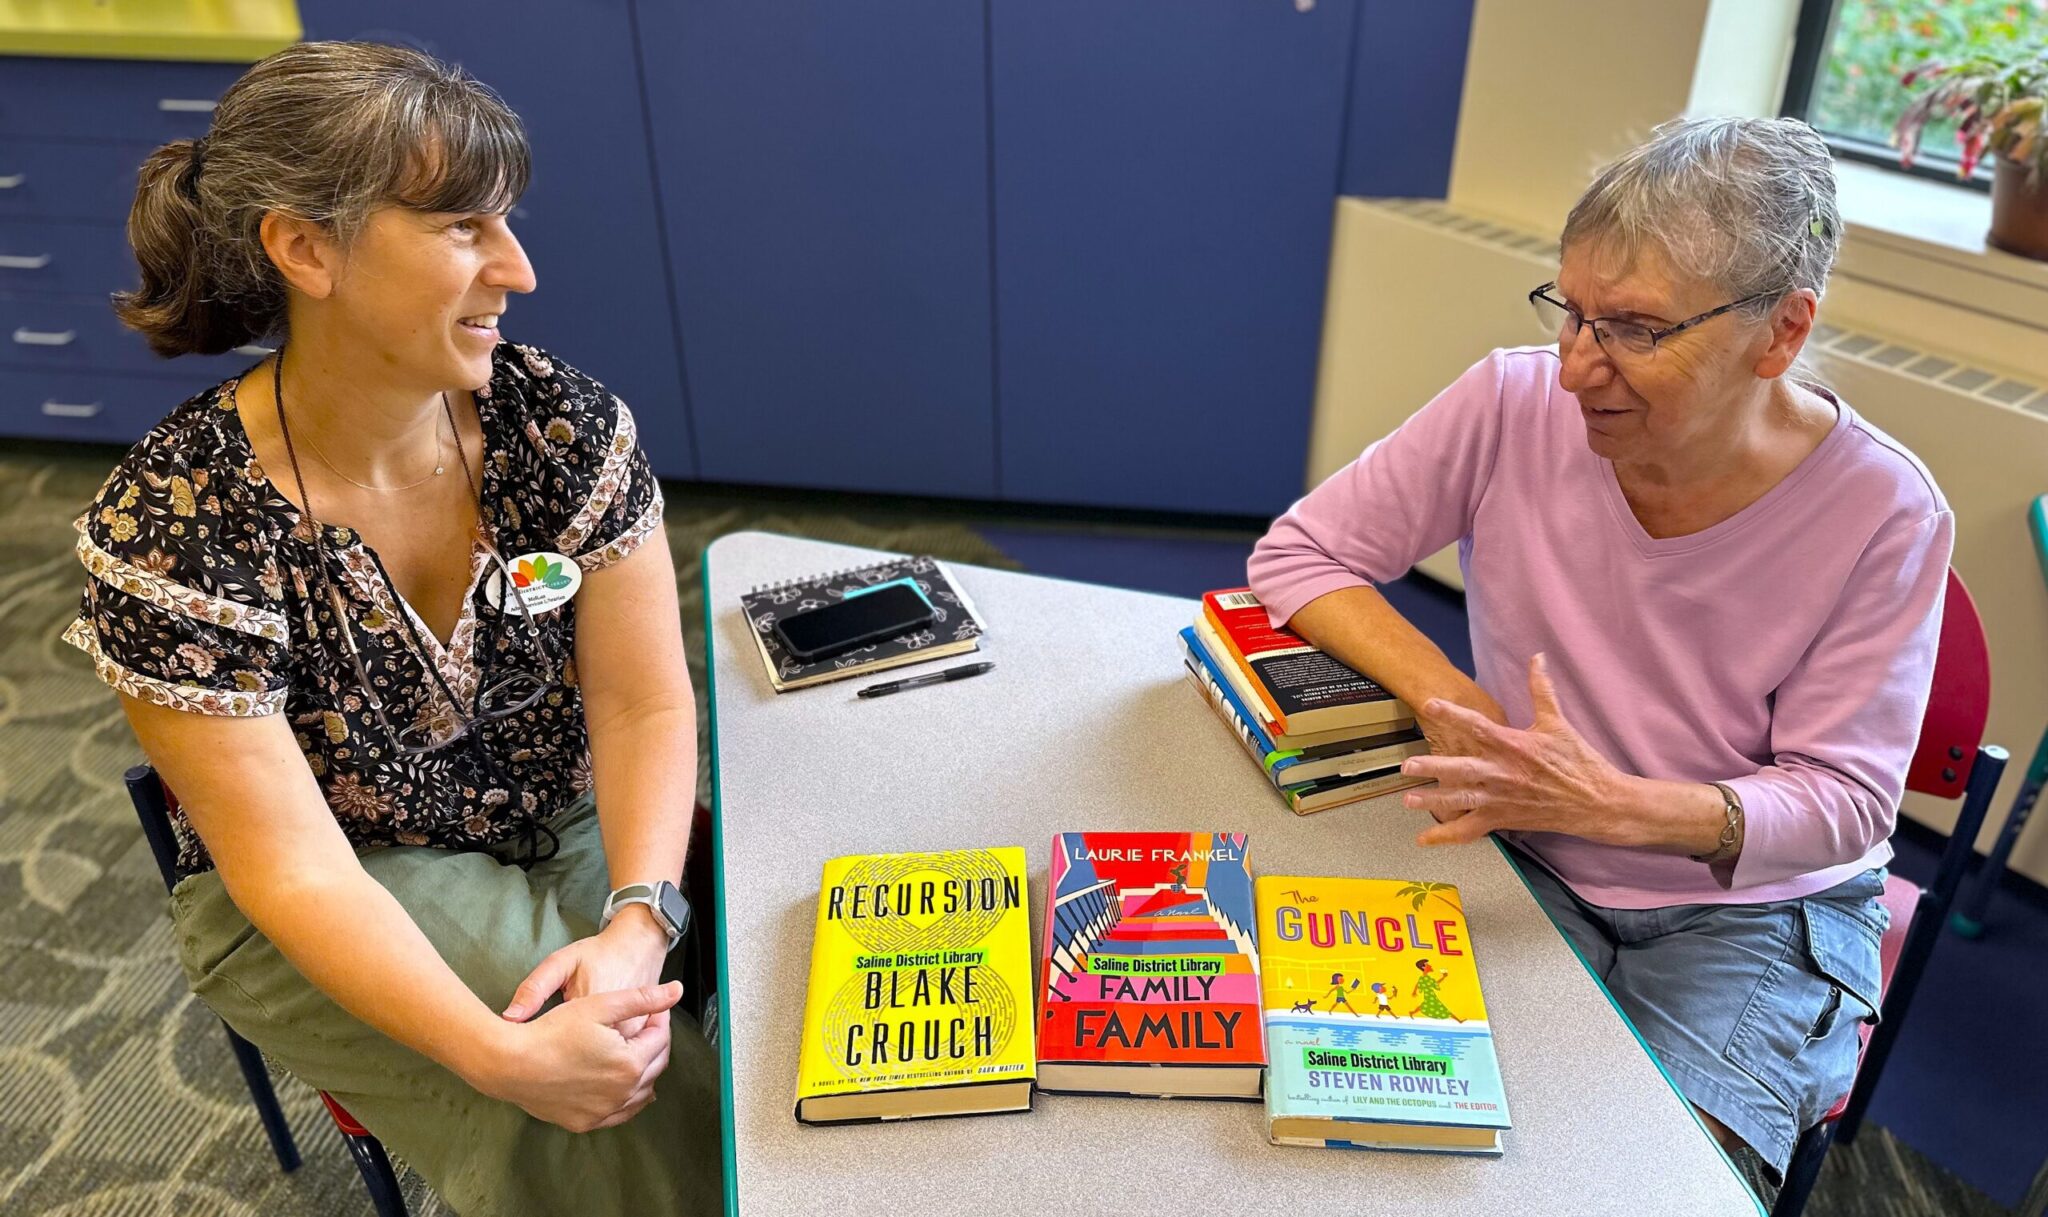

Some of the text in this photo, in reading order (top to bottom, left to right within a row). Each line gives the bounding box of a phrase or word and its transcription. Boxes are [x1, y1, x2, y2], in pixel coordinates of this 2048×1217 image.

[1075, 847, 1239, 862] LAURIE FRANKEL
[828, 876, 1020, 920] RECURSION
[1280, 890, 1318, 905] The
[1276, 906, 1463, 956] GUNCLE
[856, 951, 983, 969] Saline District Library
[1093, 957, 1221, 973] Saline District Library
[865, 965, 980, 1009] BLAKE
[1100, 974, 1216, 1001] FAMILY
[845, 1016, 992, 1067] CROUCH
[1075, 1010, 1242, 1049] FAMILY
[978, 1066, 995, 1074] DARK
[999, 1064, 1024, 1072] MATTER
[1308, 1050, 1447, 1075] Saline District Library
[1309, 1070, 1469, 1097] STEVEN ROWLEY
[1352, 1096, 1368, 1104] LILY
[1369, 1097, 1385, 1105] AND
[1387, 1098, 1400, 1106] THE
[1402, 1098, 1437, 1108] OCTOPUS
[1454, 1101, 1469, 1109] THE
[1471, 1102, 1498, 1111] EDITOR
